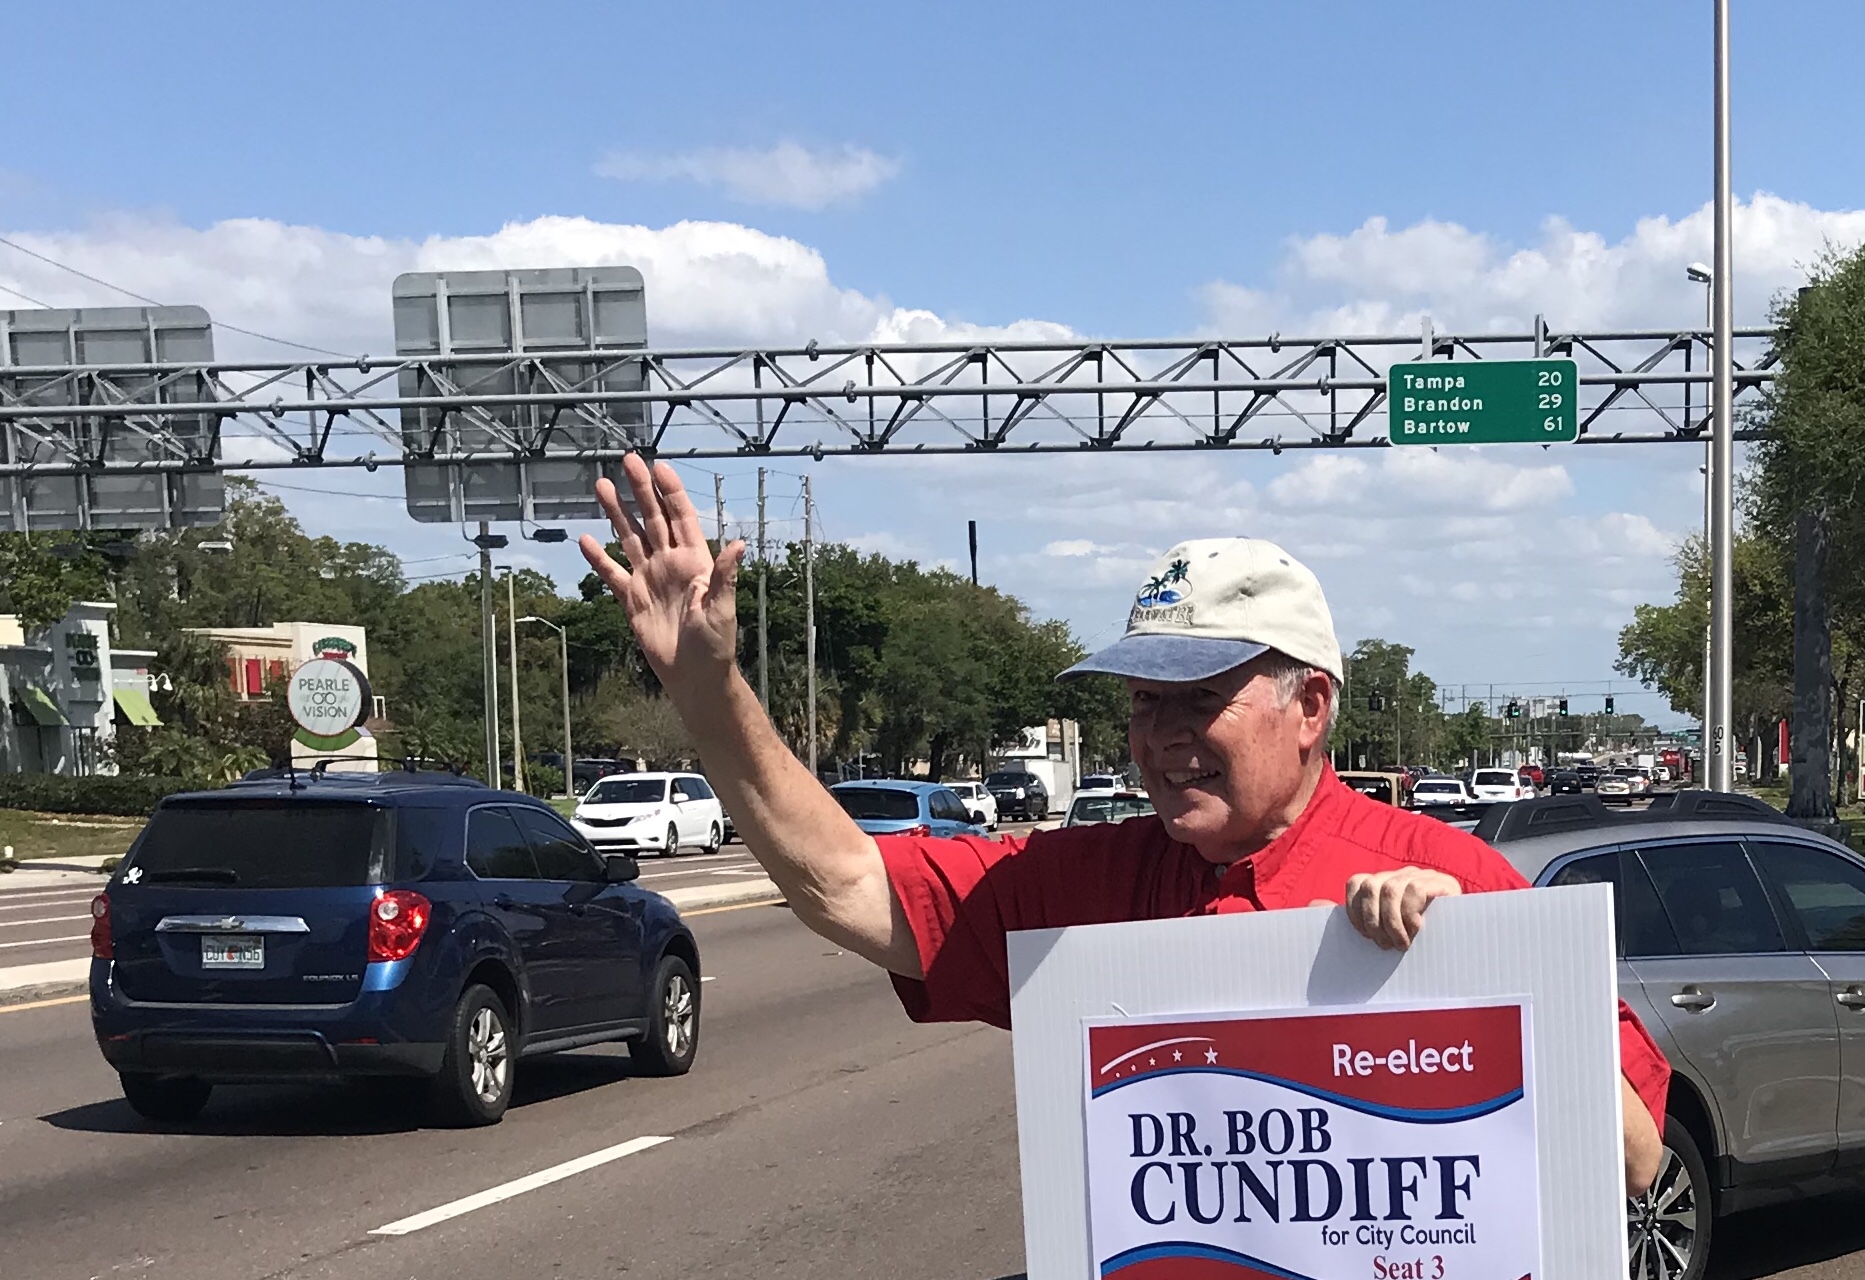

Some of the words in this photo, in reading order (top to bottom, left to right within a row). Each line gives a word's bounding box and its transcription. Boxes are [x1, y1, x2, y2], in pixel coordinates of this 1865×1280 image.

[1403, 374, 1465, 391] Tampa
[1538, 371, 1562, 386] 20
[1403, 397, 1483, 411] Brandon
[1538, 394, 1562, 409] 29
[1403, 419, 1470, 434] Bartow
[1543, 416, 1563, 431] 61
[298, 679, 350, 691] PEARLE
[303, 706, 348, 718] VISION
[1713, 725, 1724, 740] 60
[1714, 740, 1721, 755] 5
[1332, 1039, 1474, 1077] Re-elect
[1128, 1112, 1213, 1157] DR.
[1223, 1108, 1332, 1155] BOB
[1130, 1155, 1481, 1225] CUNDIFF
[1321, 1225, 1350, 1246] for
[1356, 1224, 1394, 1250] City
[1400, 1223, 1477, 1245] Council
[1373, 1255, 1424, 1280] Seat
[1431, 1255, 1445, 1280] 3
